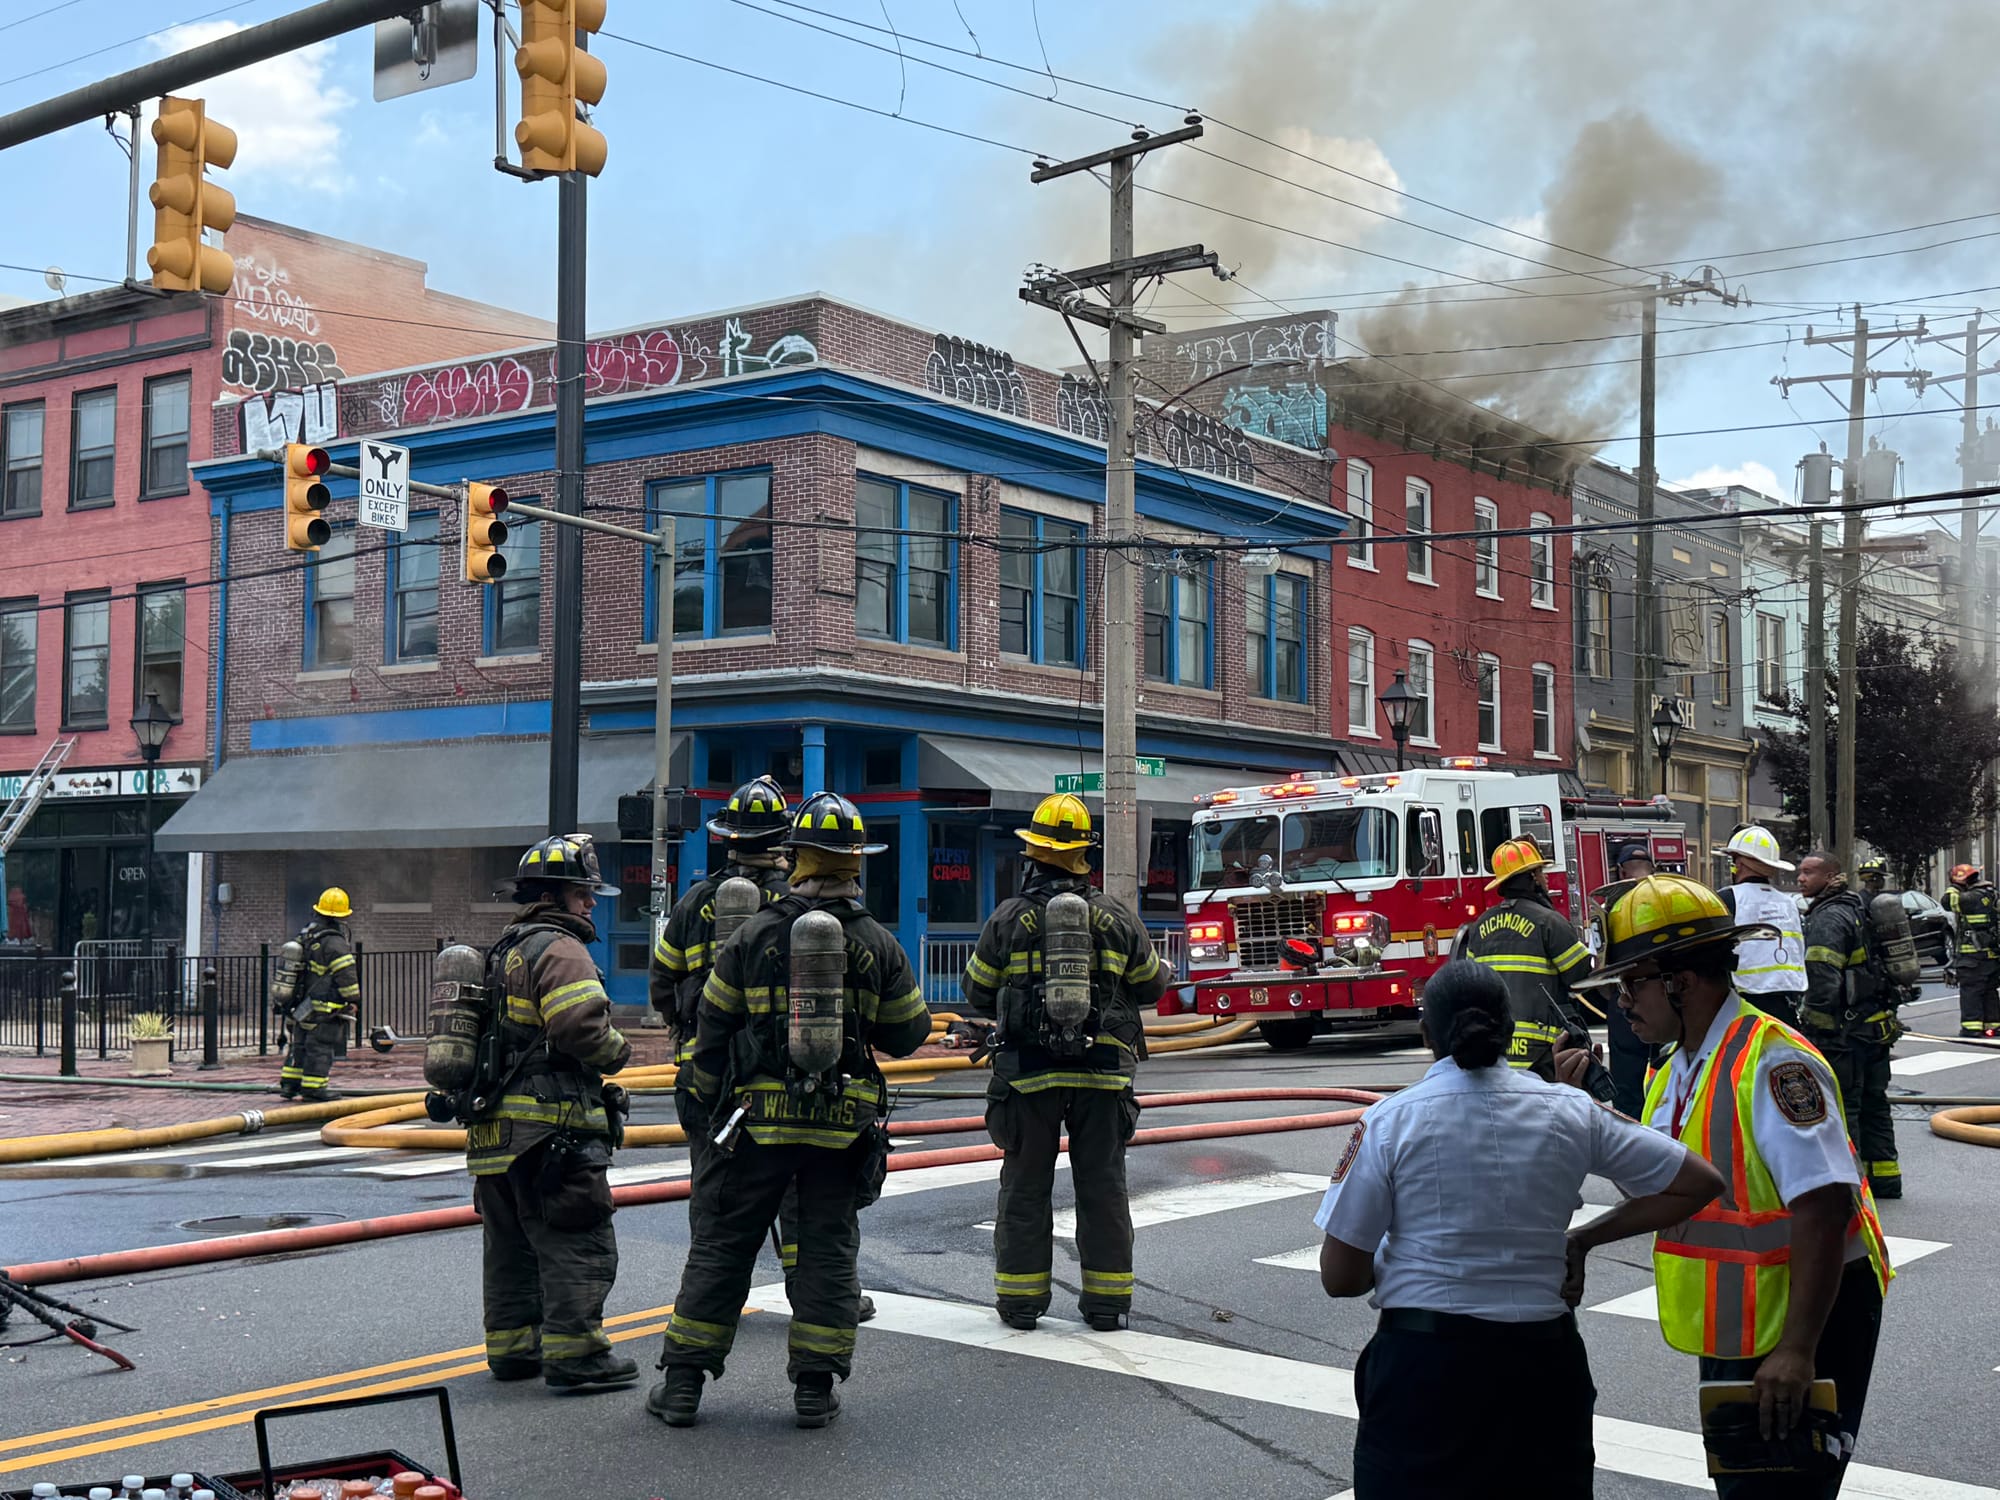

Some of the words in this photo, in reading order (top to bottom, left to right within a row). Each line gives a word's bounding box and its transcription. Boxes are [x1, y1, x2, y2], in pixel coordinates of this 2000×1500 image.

[366, 479, 403, 499] ONLY
[368, 500, 399, 515] EXCEPT
[371, 512, 396, 526] BIKES
[1135, 759, 1152, 775] Main
[120, 866, 146, 882] OPEN
[1479, 912, 1536, 939] RICHMOND
